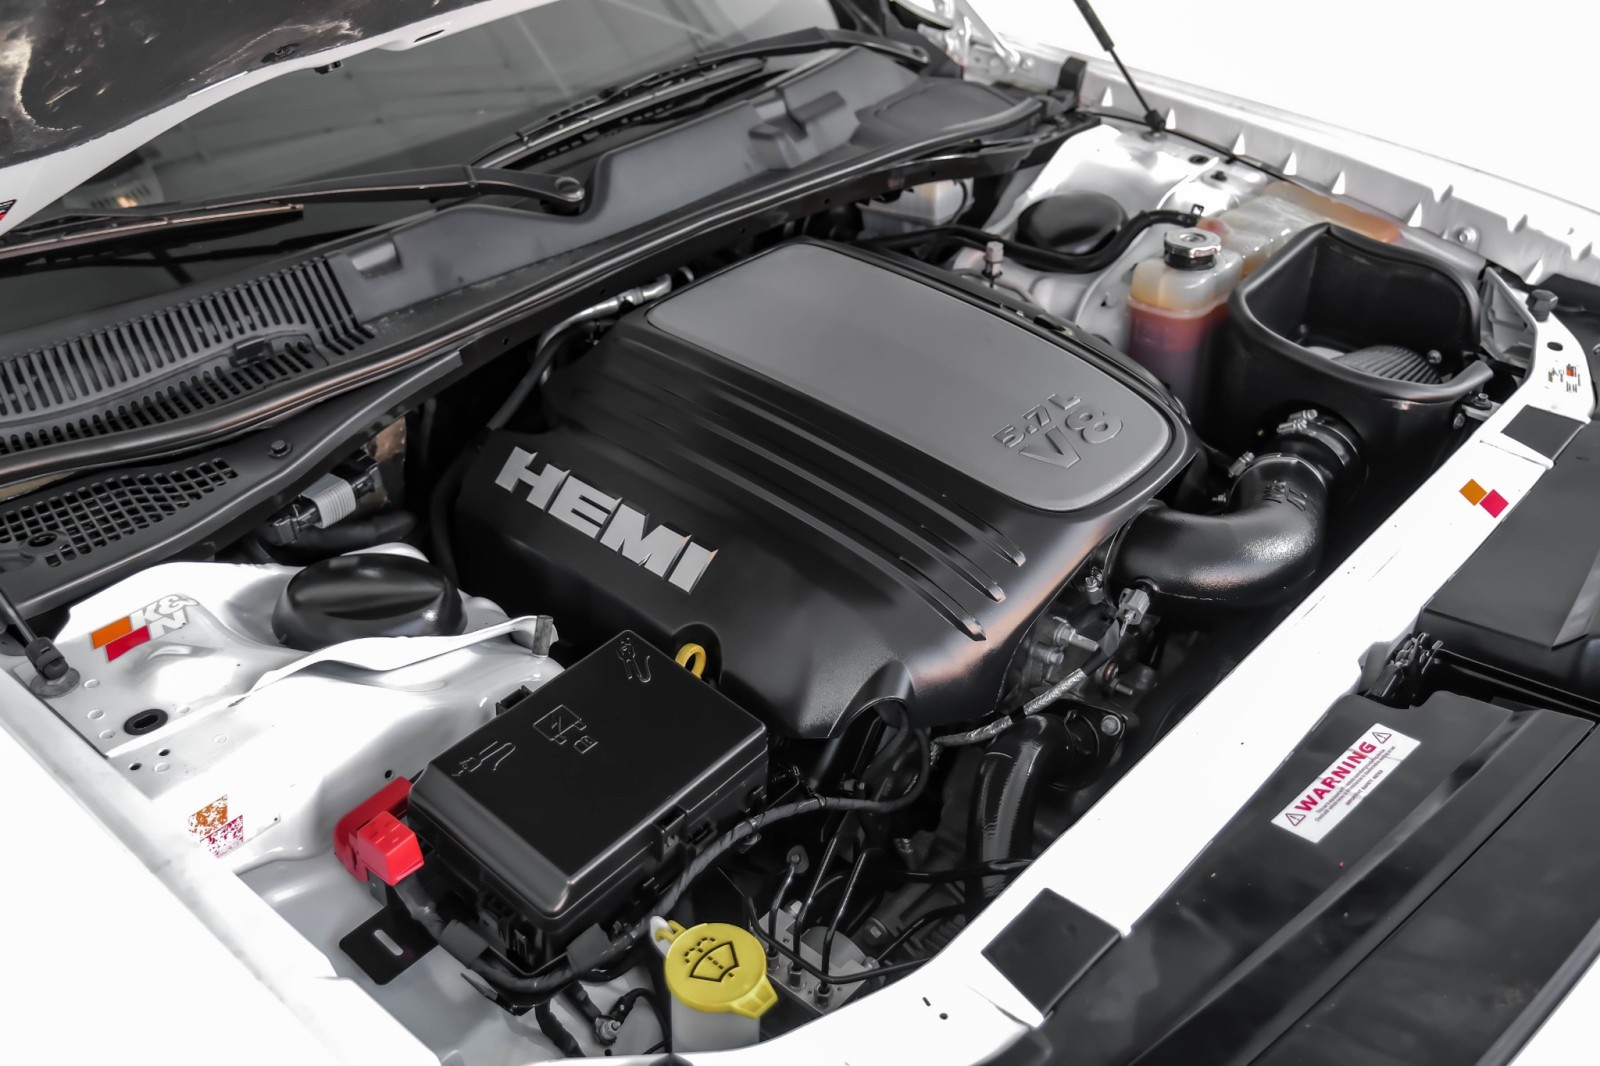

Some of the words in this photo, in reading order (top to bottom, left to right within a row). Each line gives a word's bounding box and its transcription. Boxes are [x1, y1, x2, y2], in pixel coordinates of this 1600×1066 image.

[992, 393, 1081, 448] 5.7L
[1018, 408, 1123, 469] V8
[494, 446, 719, 594] HEMI
[1294, 741, 1377, 812] WARNING
